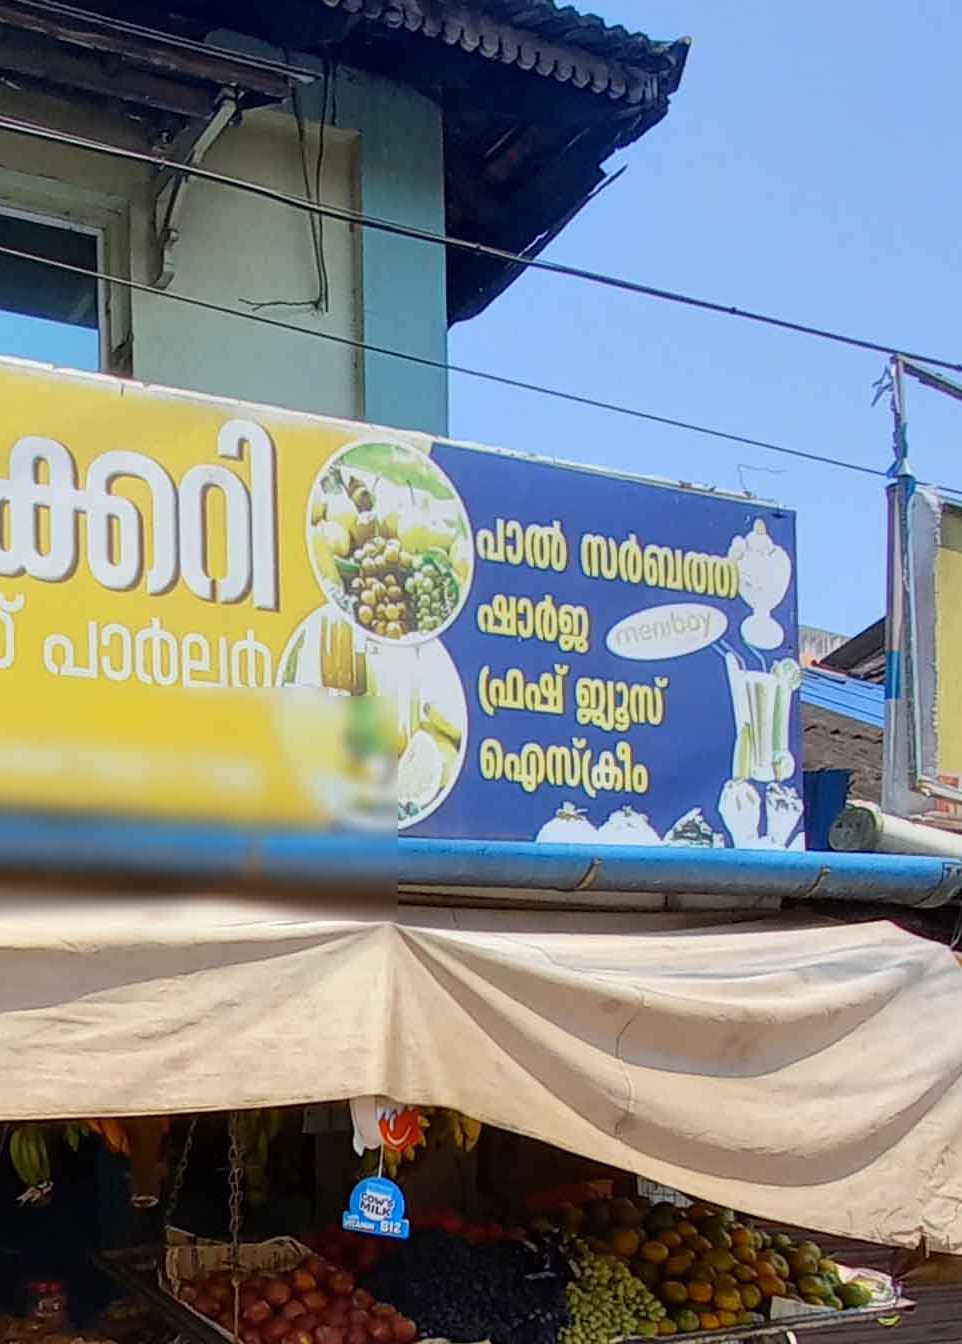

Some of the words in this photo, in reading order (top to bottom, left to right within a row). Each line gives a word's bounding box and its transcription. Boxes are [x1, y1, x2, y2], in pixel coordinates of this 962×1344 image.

[476, 517, 569, 574] പാൽ
[42, 616, 274, 690] പാർലർ
[476, 593, 591, 654] ഷാർജ
[478, 663, 570, 717] ഫ്രഷ്
[575, 675, 670, 733] ജ്യൂസ്
[479, 736, 650, 799] ഐസ്ക്രീം
[359, 1200, 391, 1217] MILK
